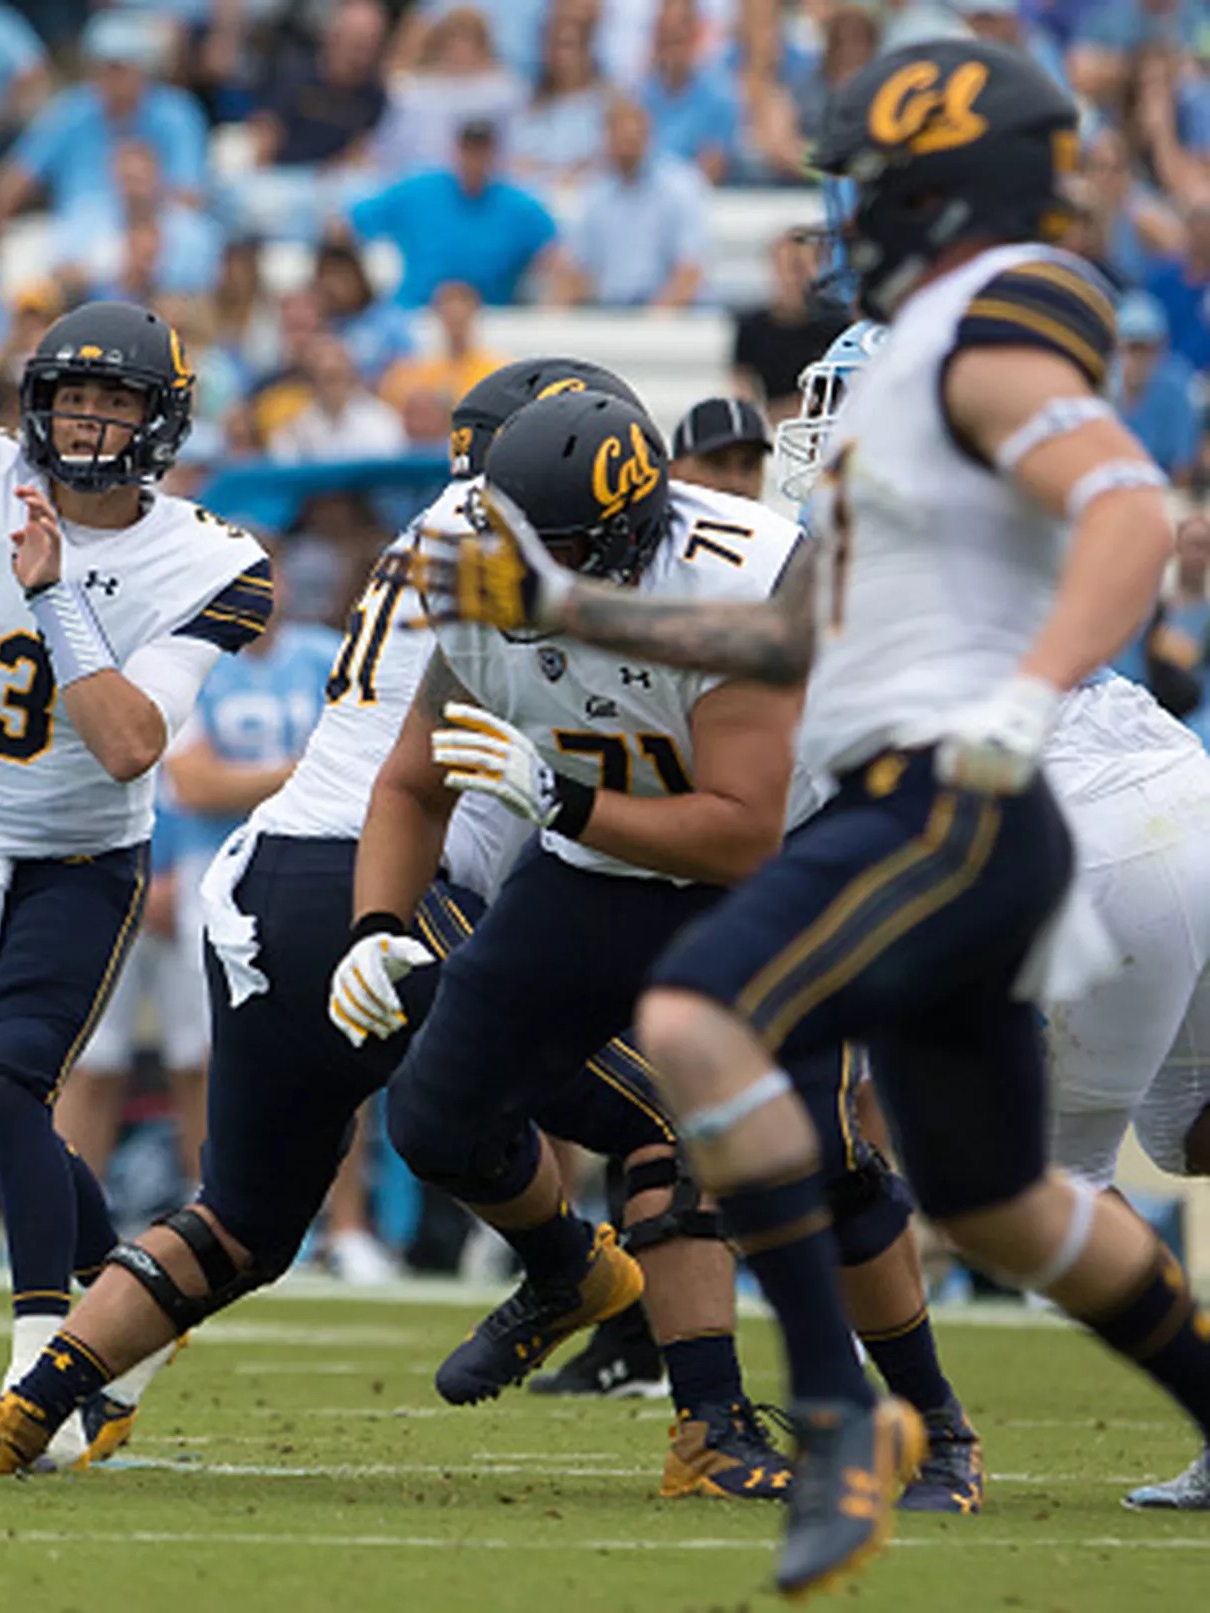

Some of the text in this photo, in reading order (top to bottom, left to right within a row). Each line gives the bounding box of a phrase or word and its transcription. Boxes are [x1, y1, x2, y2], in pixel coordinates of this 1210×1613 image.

[870, 60, 989, 154] Cal
[593, 422, 661, 520] Cal
[683, 516, 756, 569] 71
[552, 728, 695, 794] 71
